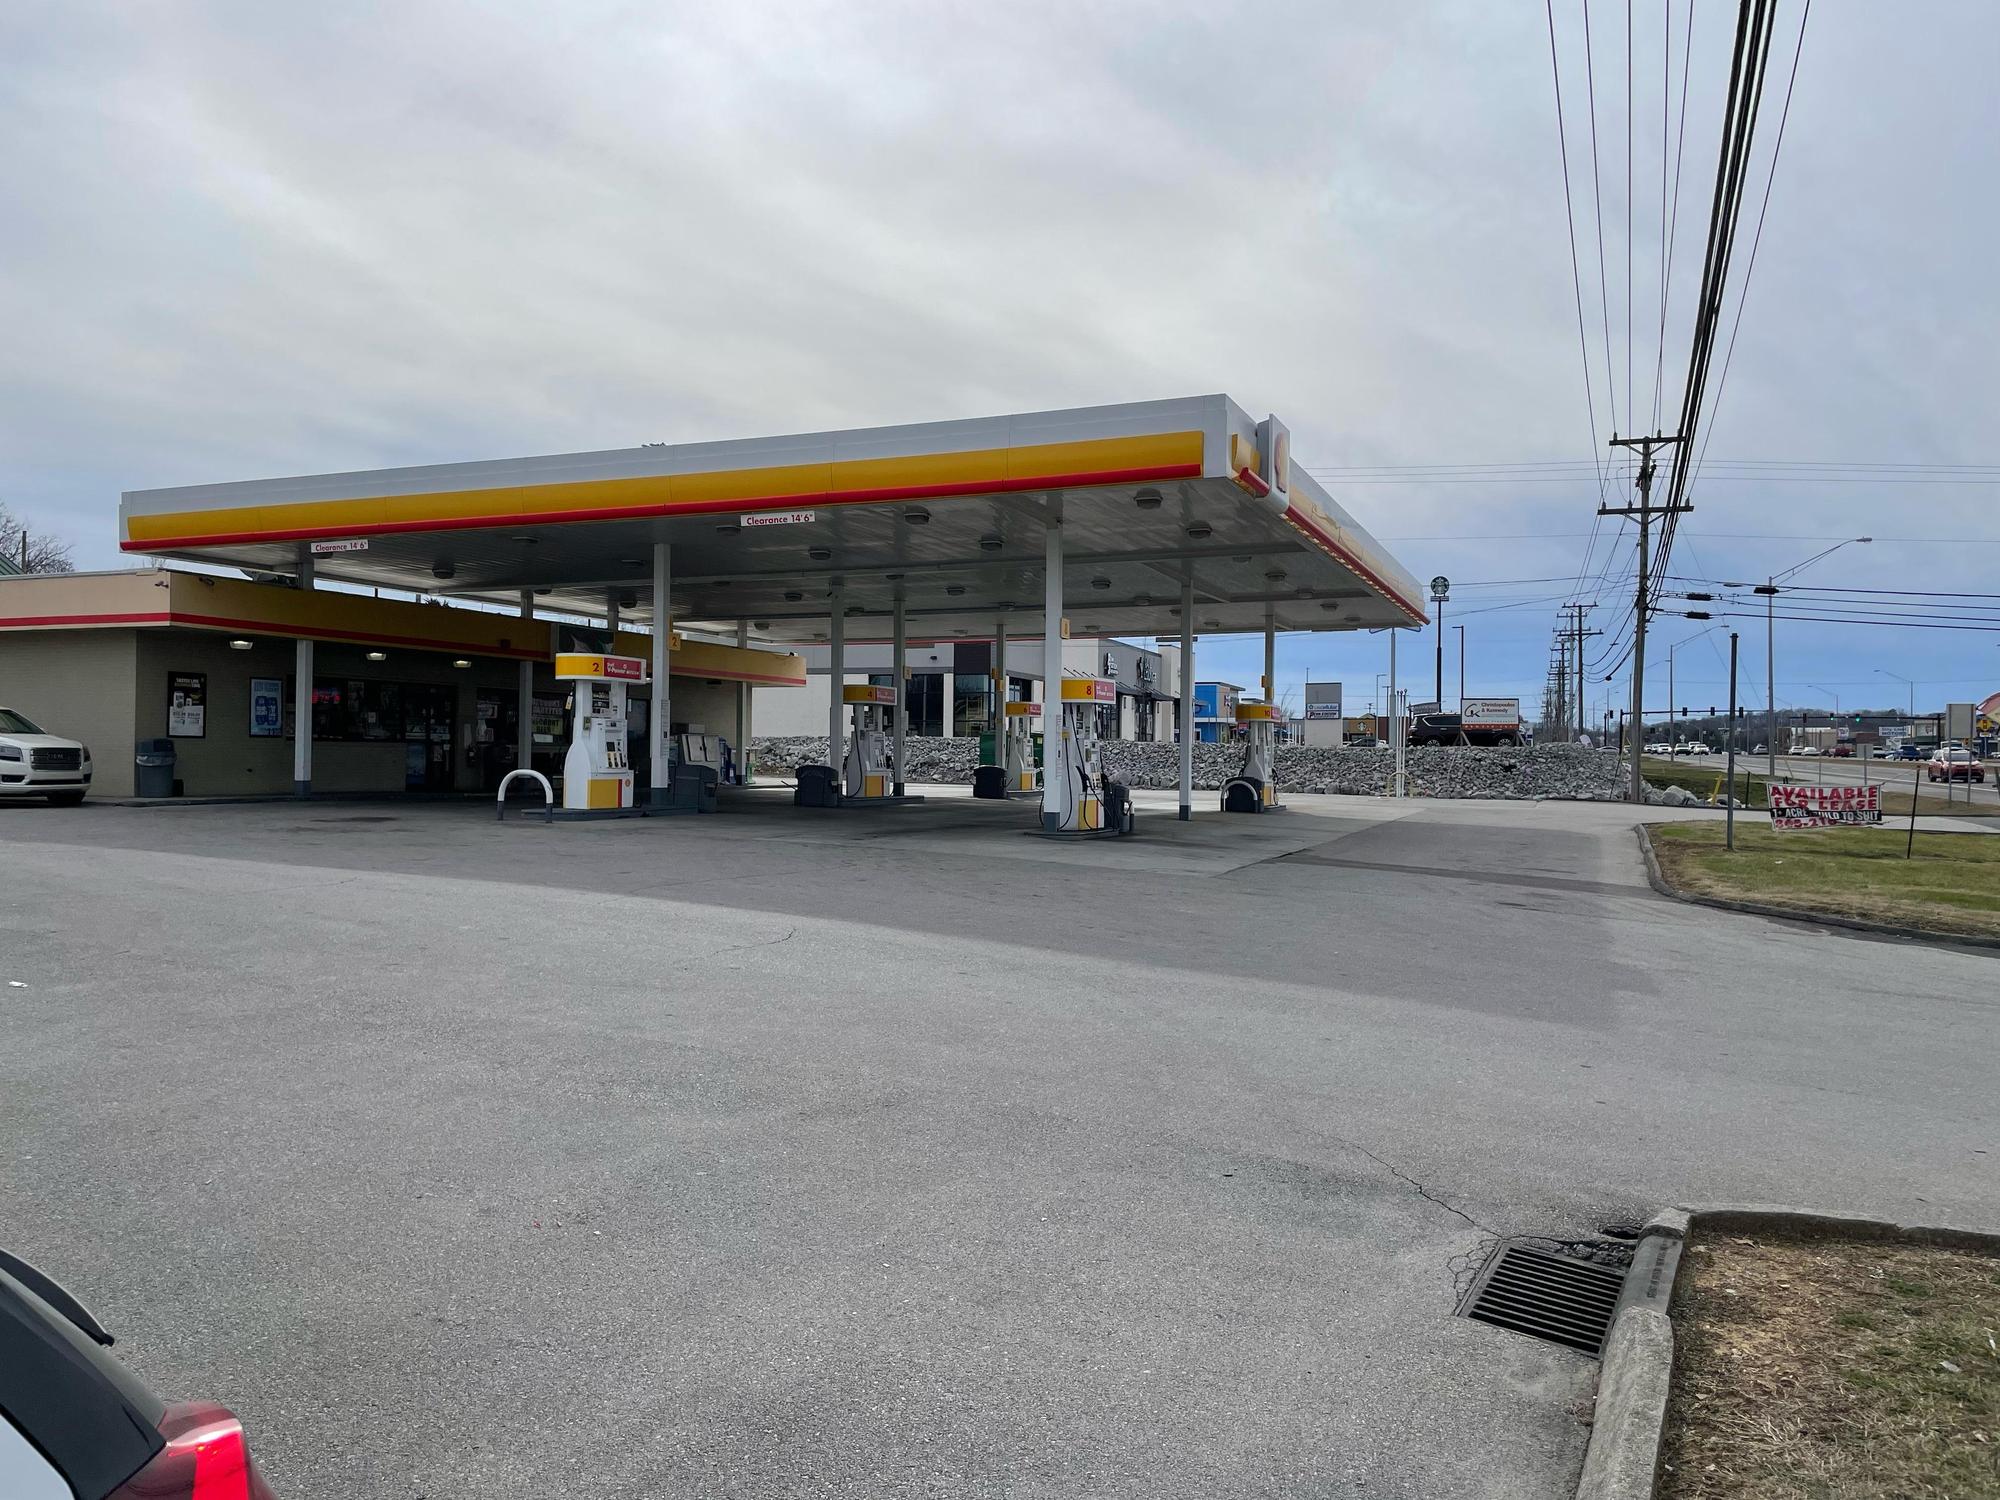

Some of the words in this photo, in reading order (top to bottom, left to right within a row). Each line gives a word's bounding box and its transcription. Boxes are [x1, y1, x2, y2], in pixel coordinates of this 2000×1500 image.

[746, 516, 788, 525] Clearance
[672, 636, 677, 647] 2
[592, 662, 600, 672] 2
[1086, 685, 1092, 695] 8
[1771, 785, 1877, 800] AVAILABLE
[1774, 797, 1808, 808] FOR
[1818, 800, 1877, 810] LEASE
[1785, 808, 1808, 817] ACRE
[1842, 811, 1854, 820] TO
[1856, 811, 1879, 820] SUIT
